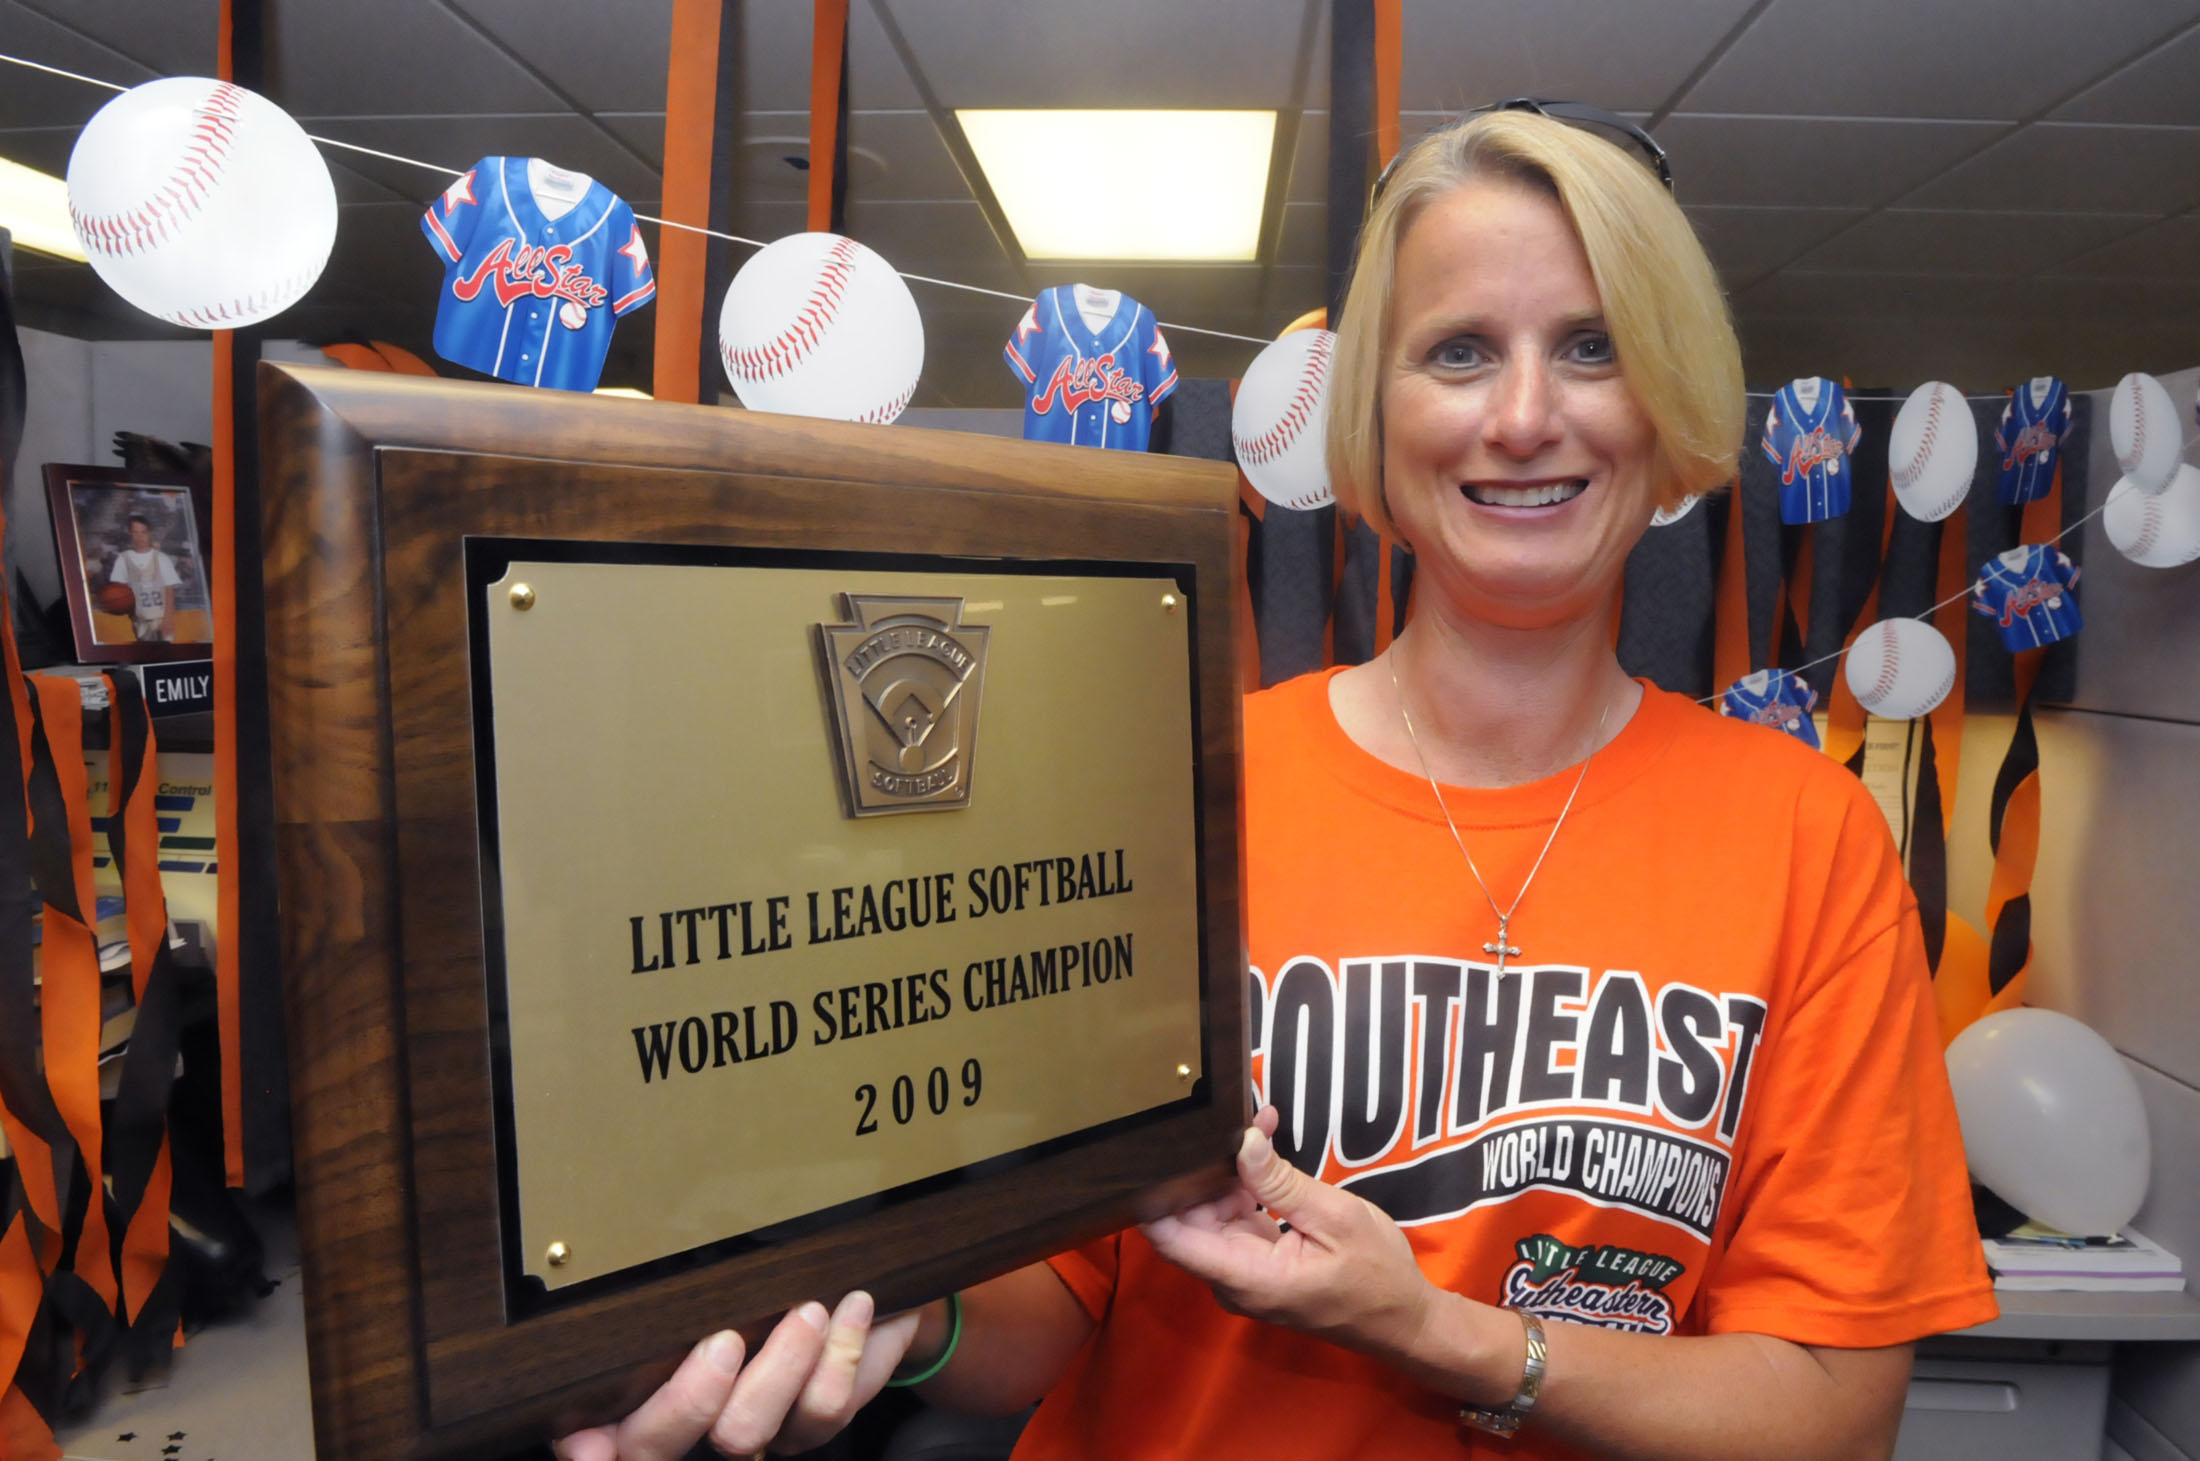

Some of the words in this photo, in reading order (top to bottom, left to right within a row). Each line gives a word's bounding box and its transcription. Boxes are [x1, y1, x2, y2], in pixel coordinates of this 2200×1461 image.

[847, 632, 900, 676] LITTLE
[155, 675, 210, 703] EMILY
[158, 782, 212, 796] Control
[629, 895, 793, 975] LITTLE
[806, 872, 957, 945] LEAGUE
[967, 848, 1134, 919] SOFTBALL
[631, 1000, 798, 1084] WORLD
[812, 968, 952, 1046] SERIES
[963, 932, 1134, 1013] CHAMPION
[854, 1058, 983, 1137] 2009
[1482, 1124, 1575, 1193] WORLD
[1581, 1127, 1722, 1229] CHAMPIONS
[1519, 1239, 1589, 1270] LITLE
[1595, 1250, 1678, 1283] LEAGUE
